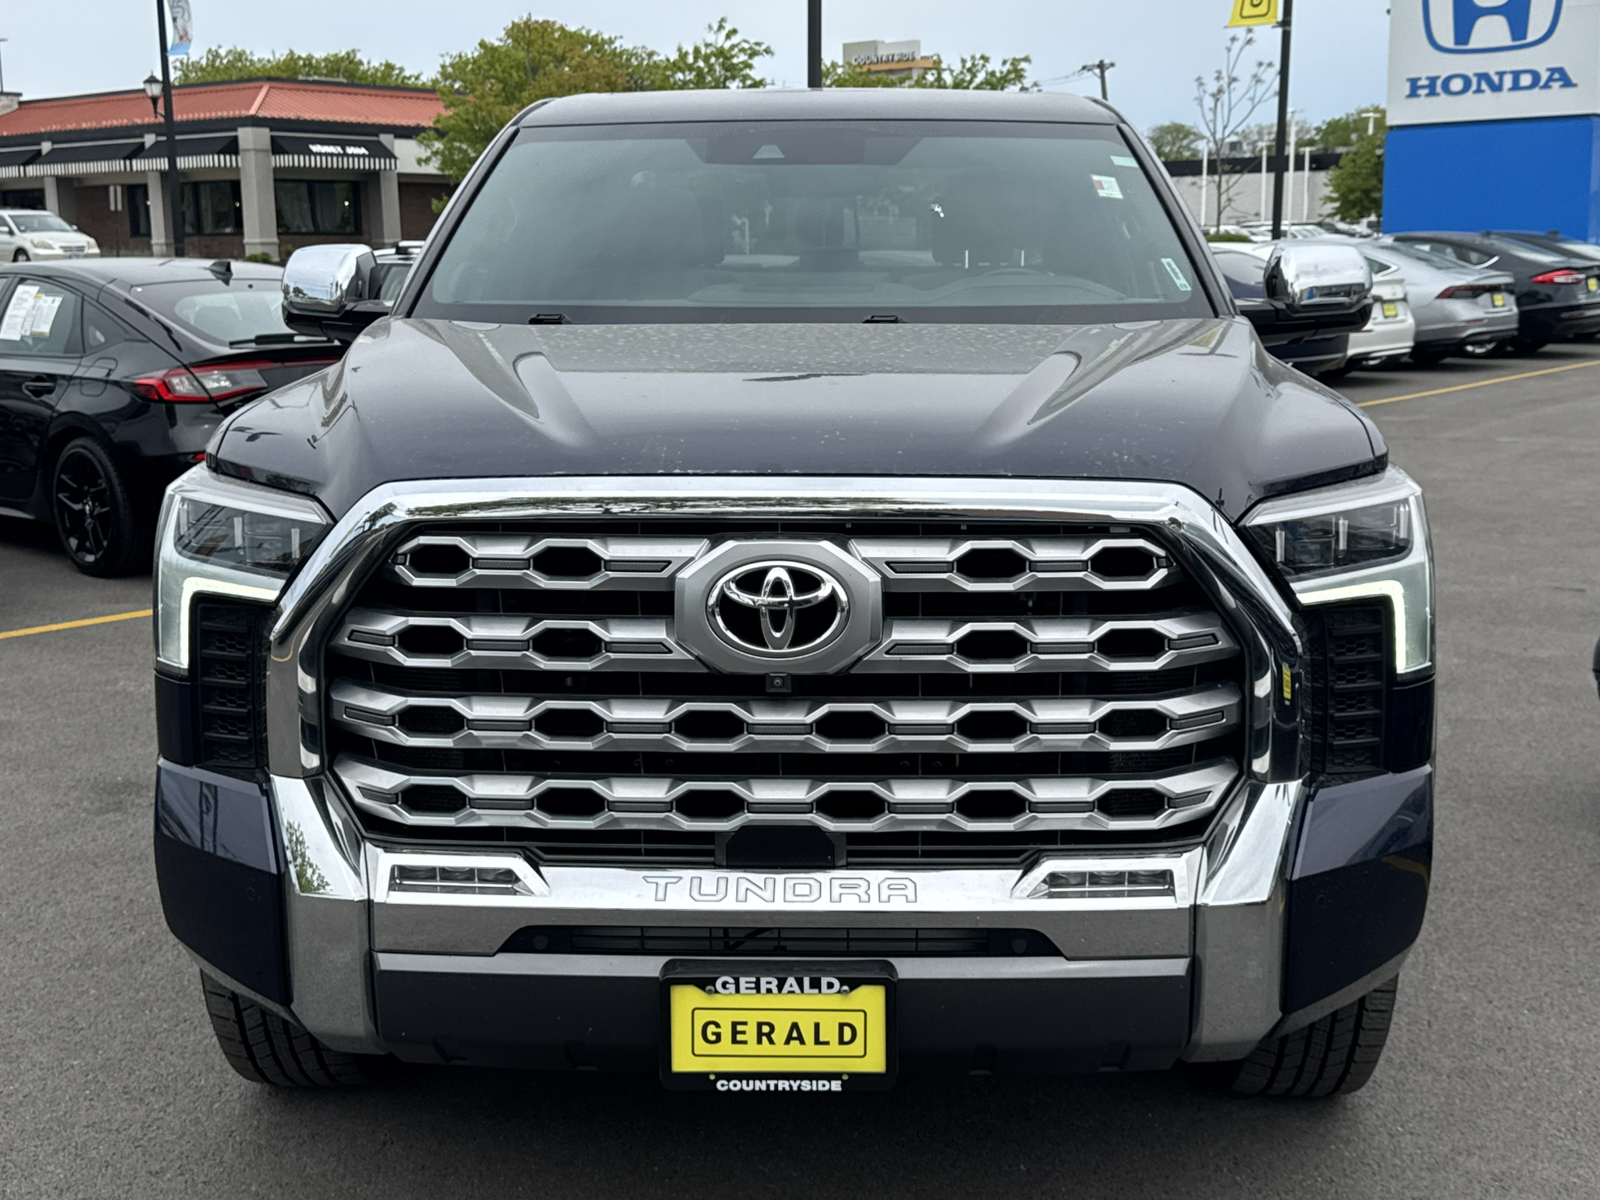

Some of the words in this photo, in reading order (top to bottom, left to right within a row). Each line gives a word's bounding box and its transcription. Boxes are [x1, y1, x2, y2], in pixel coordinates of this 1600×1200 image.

[1405, 66, 1578, 99] HONDA
[642, 875, 918, 904] TUNDRA
[715, 976, 841, 995] GERALD
[700, 1020, 858, 1046] GERALD
[716, 1079, 842, 1092] COUNTRYSIDE
